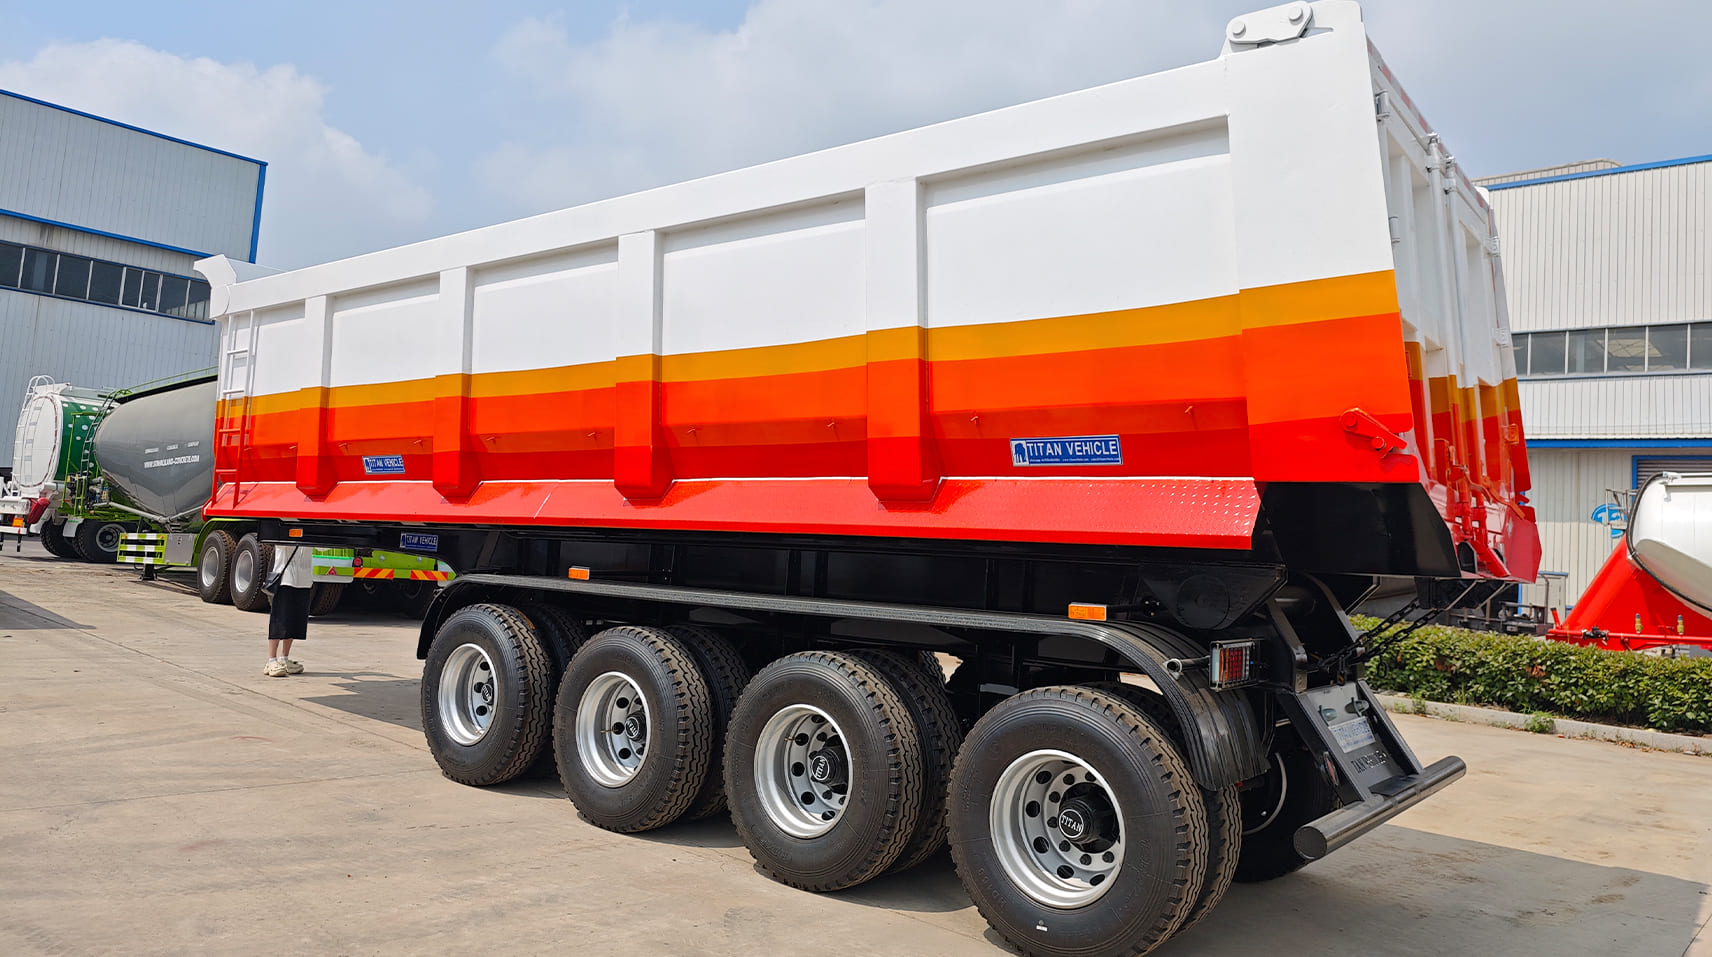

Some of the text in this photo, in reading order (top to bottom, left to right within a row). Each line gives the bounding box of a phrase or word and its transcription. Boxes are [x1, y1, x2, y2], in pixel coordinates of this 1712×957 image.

[1027, 441, 1118, 456] TITAN VEHICLE
[384, 458, 404, 467] VEHICLE
[420, 536, 437, 545] VEHICLE
[1061, 815, 1083, 833] TITAN
